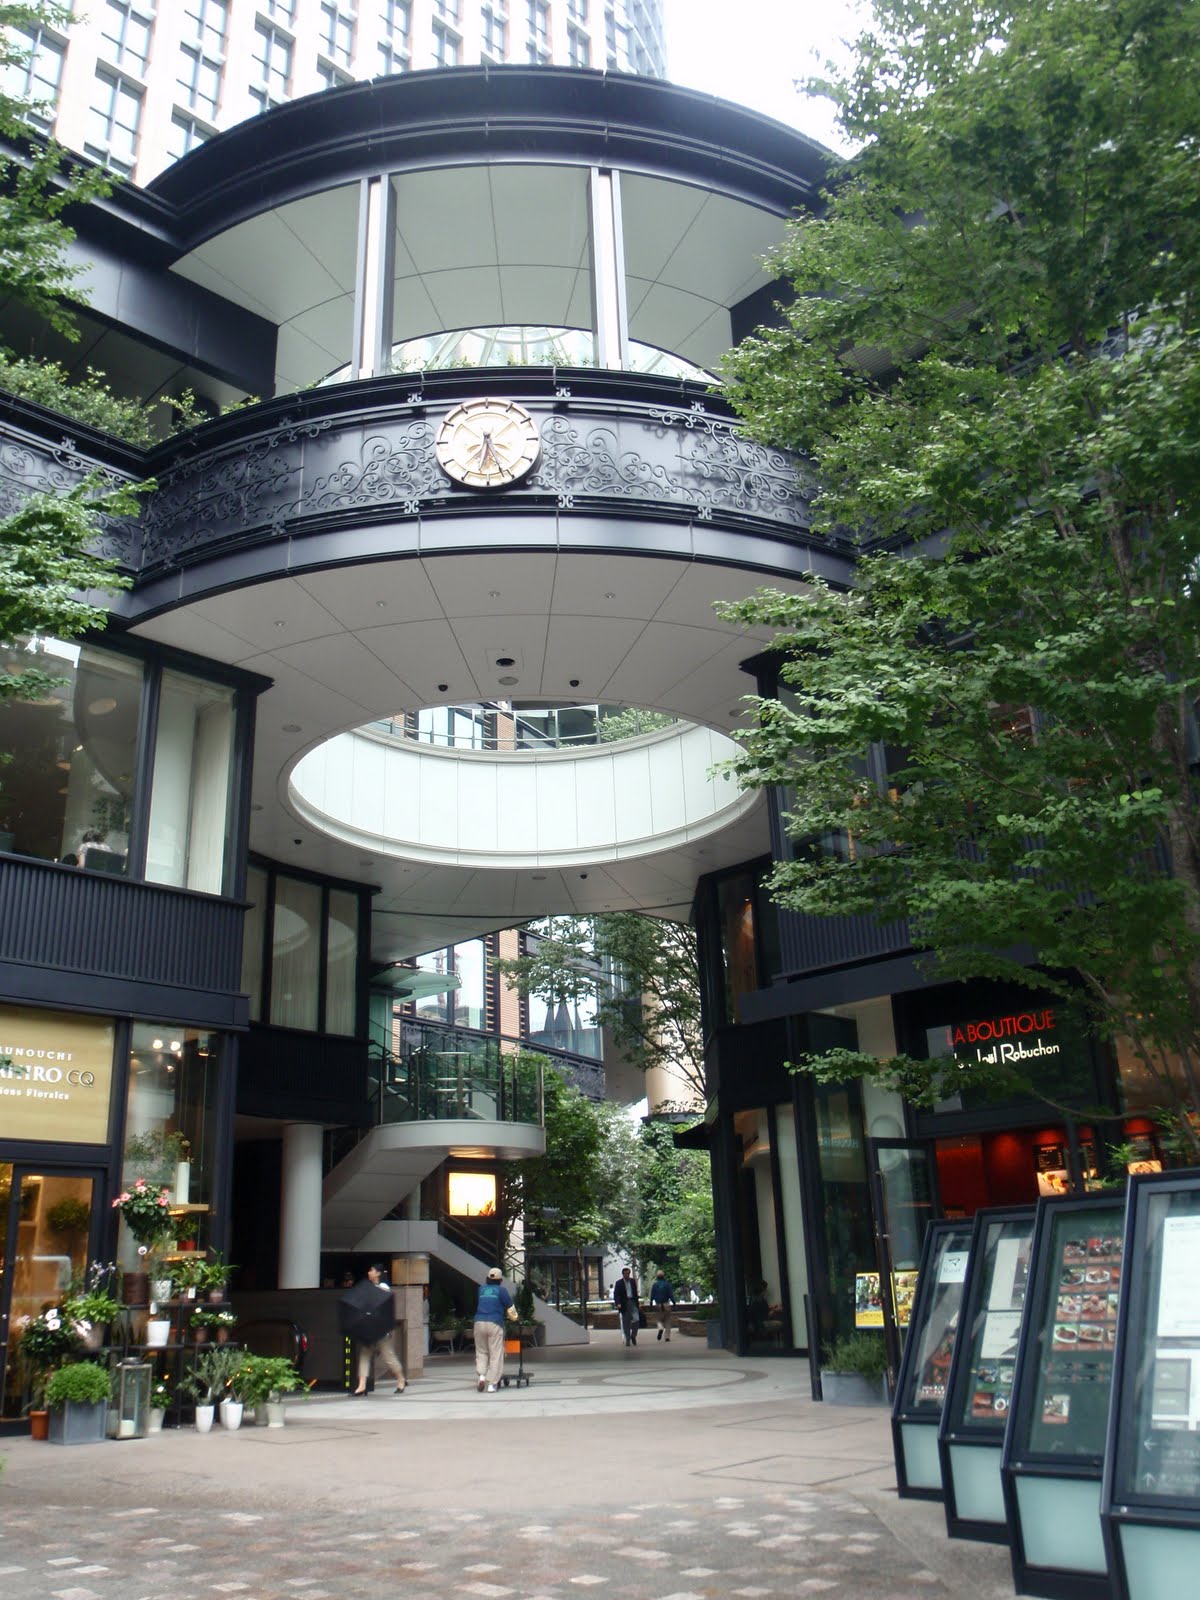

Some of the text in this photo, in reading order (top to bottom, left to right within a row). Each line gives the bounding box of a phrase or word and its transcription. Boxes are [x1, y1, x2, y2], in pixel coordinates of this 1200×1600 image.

[946, 1009, 1056, 1046] LA BOUTIQUE
[0, 1046, 73, 1062] UNOUCHI
[1000, 1038, 1060, 1065] Robuchon
[66, 1069, 95, 1088] CQ
[26, 1088, 70, 1100] Florales
